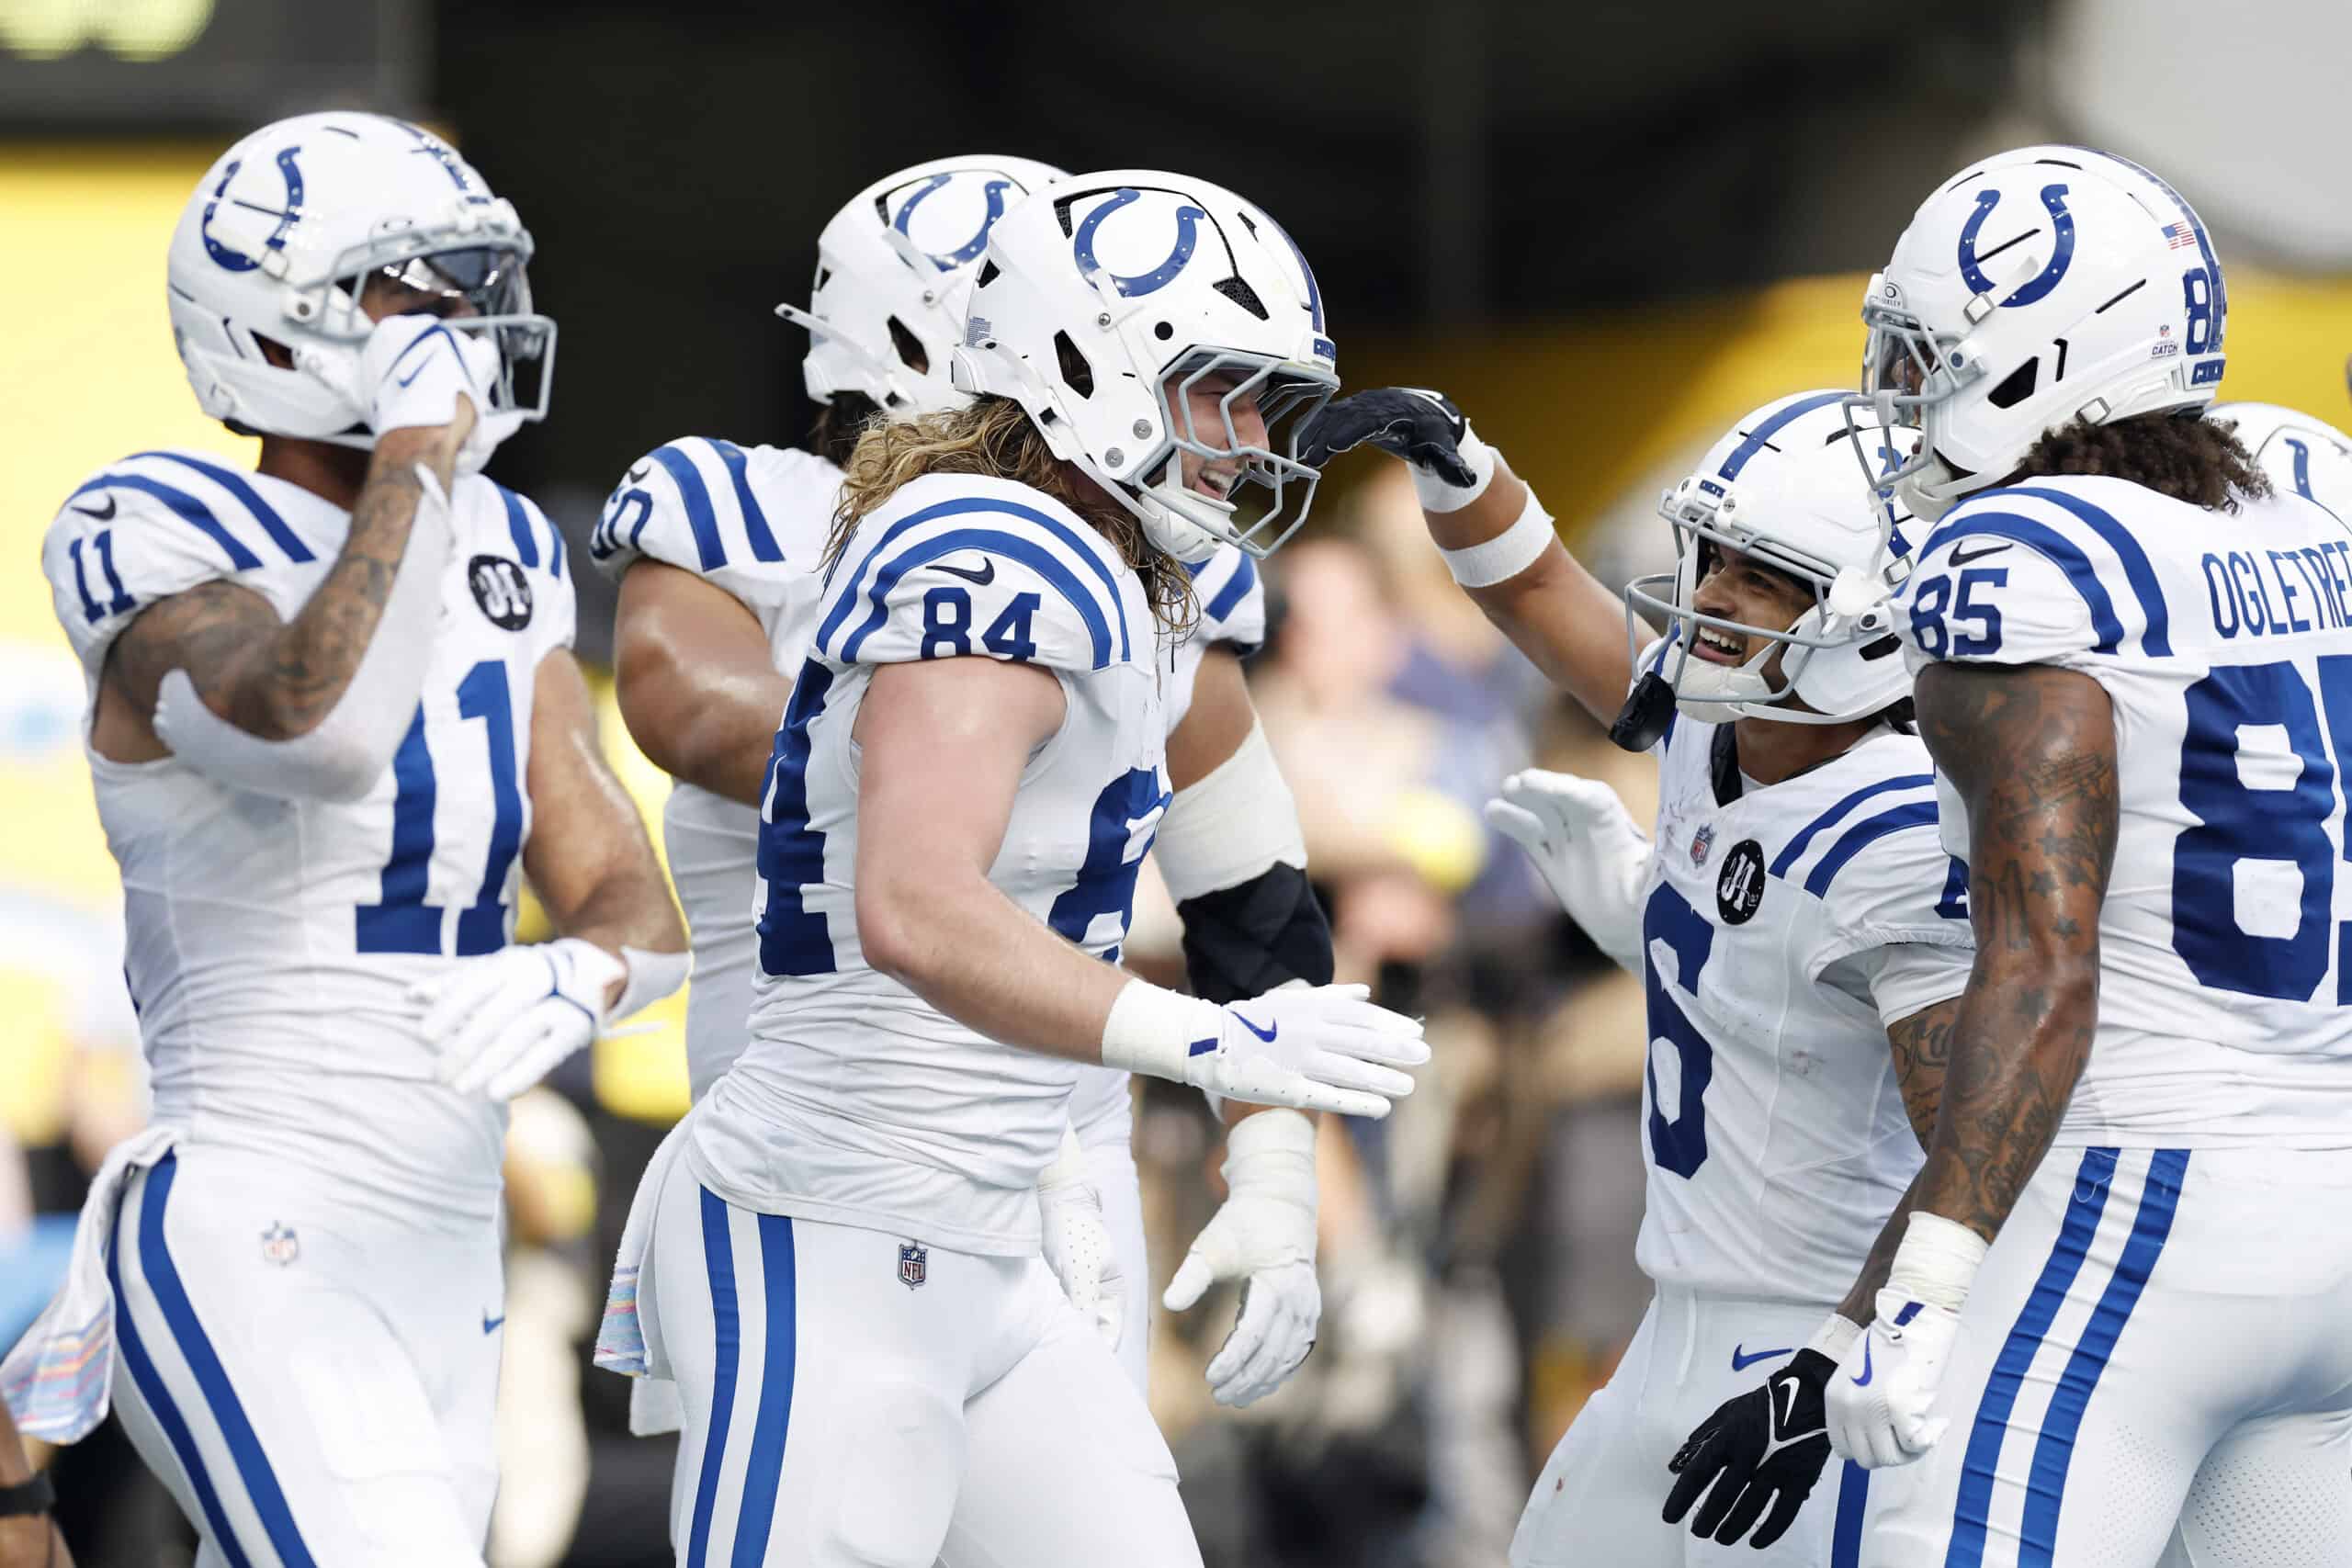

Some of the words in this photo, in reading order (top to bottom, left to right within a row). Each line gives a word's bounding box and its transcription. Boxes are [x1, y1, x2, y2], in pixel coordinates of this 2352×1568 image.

[2152, 343, 2178, 355] CATCH
[70, 529, 137, 624] 11
[1910, 568, 2008, 660] 85
[921, 587, 1042, 661] 84
[356, 660, 523, 956] 11
[2172, 653, 2352, 1007] 8
[1643, 880, 1714, 1180] 6
[903, 1260, 923, 1280] NFL
